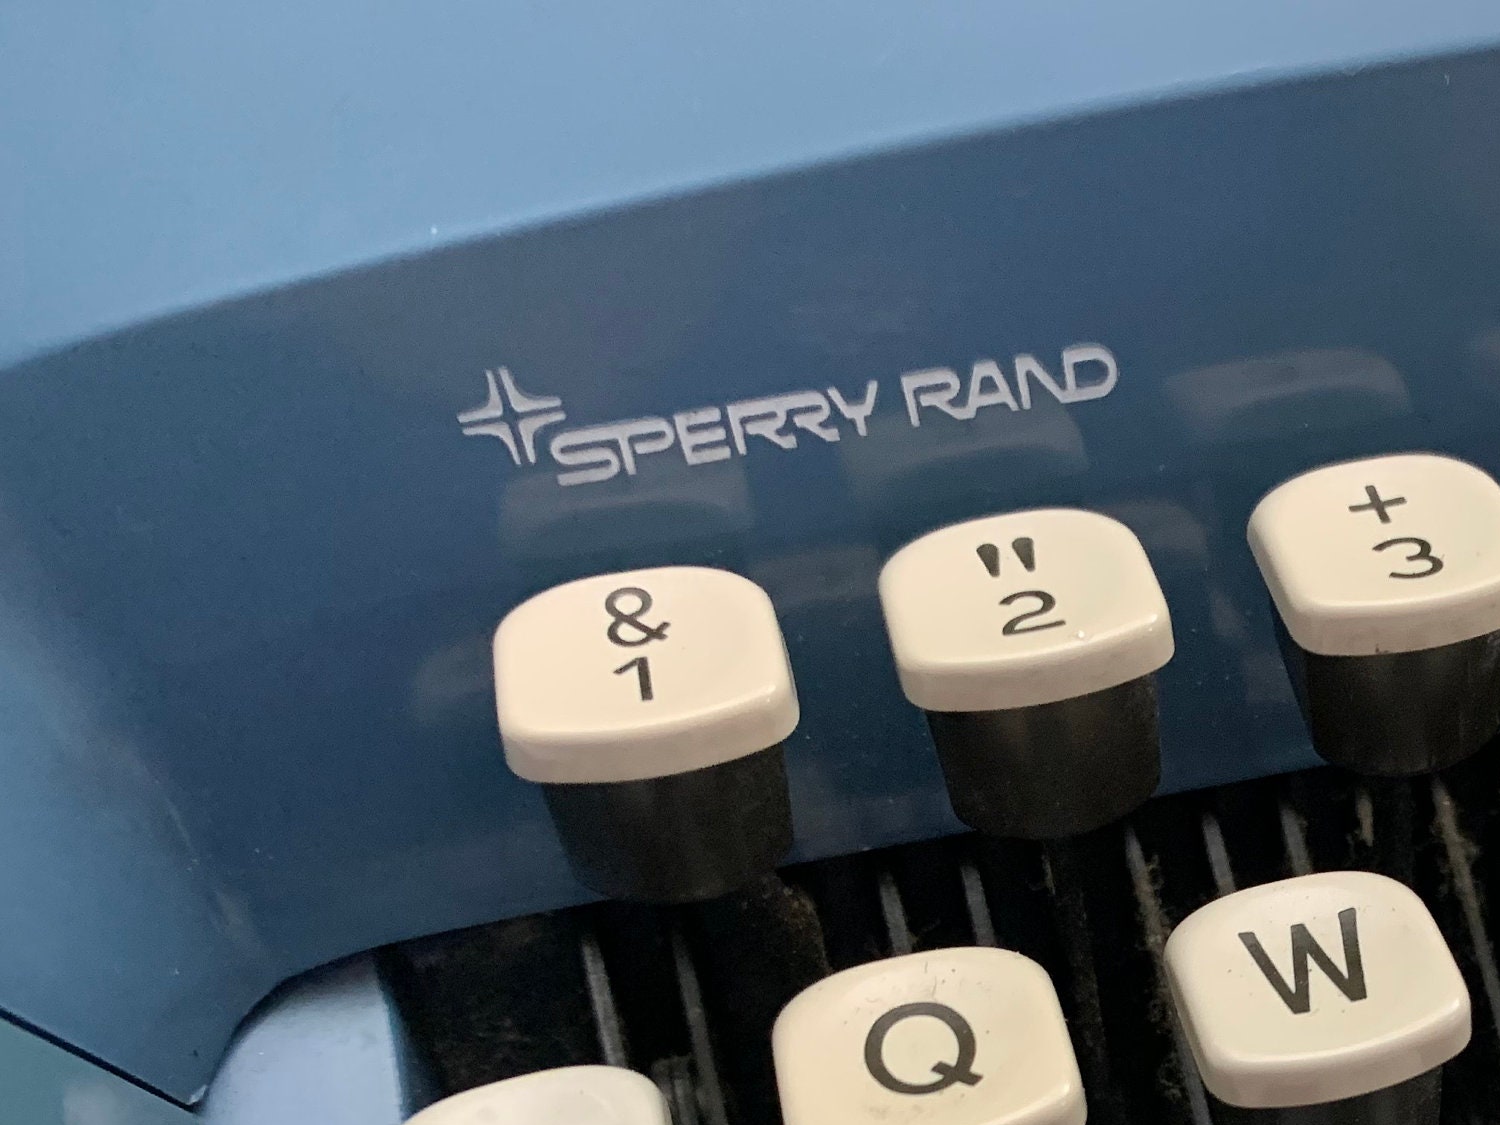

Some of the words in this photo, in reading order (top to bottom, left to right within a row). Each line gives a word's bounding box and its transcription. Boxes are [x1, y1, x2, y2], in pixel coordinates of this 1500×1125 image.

[550, 380, 878, 486] SPERRY
[901, 343, 1119, 426] RAND
[1348, 484, 1407, 524] +
[1372, 537, 1444, 579] 3
[604, 587, 670, 648] &
[999, 589, 1066, 636] 2
[612, 657, 655, 702] 1
[1238, 906, 1368, 1013] W
[863, 1001, 984, 1096] Q
